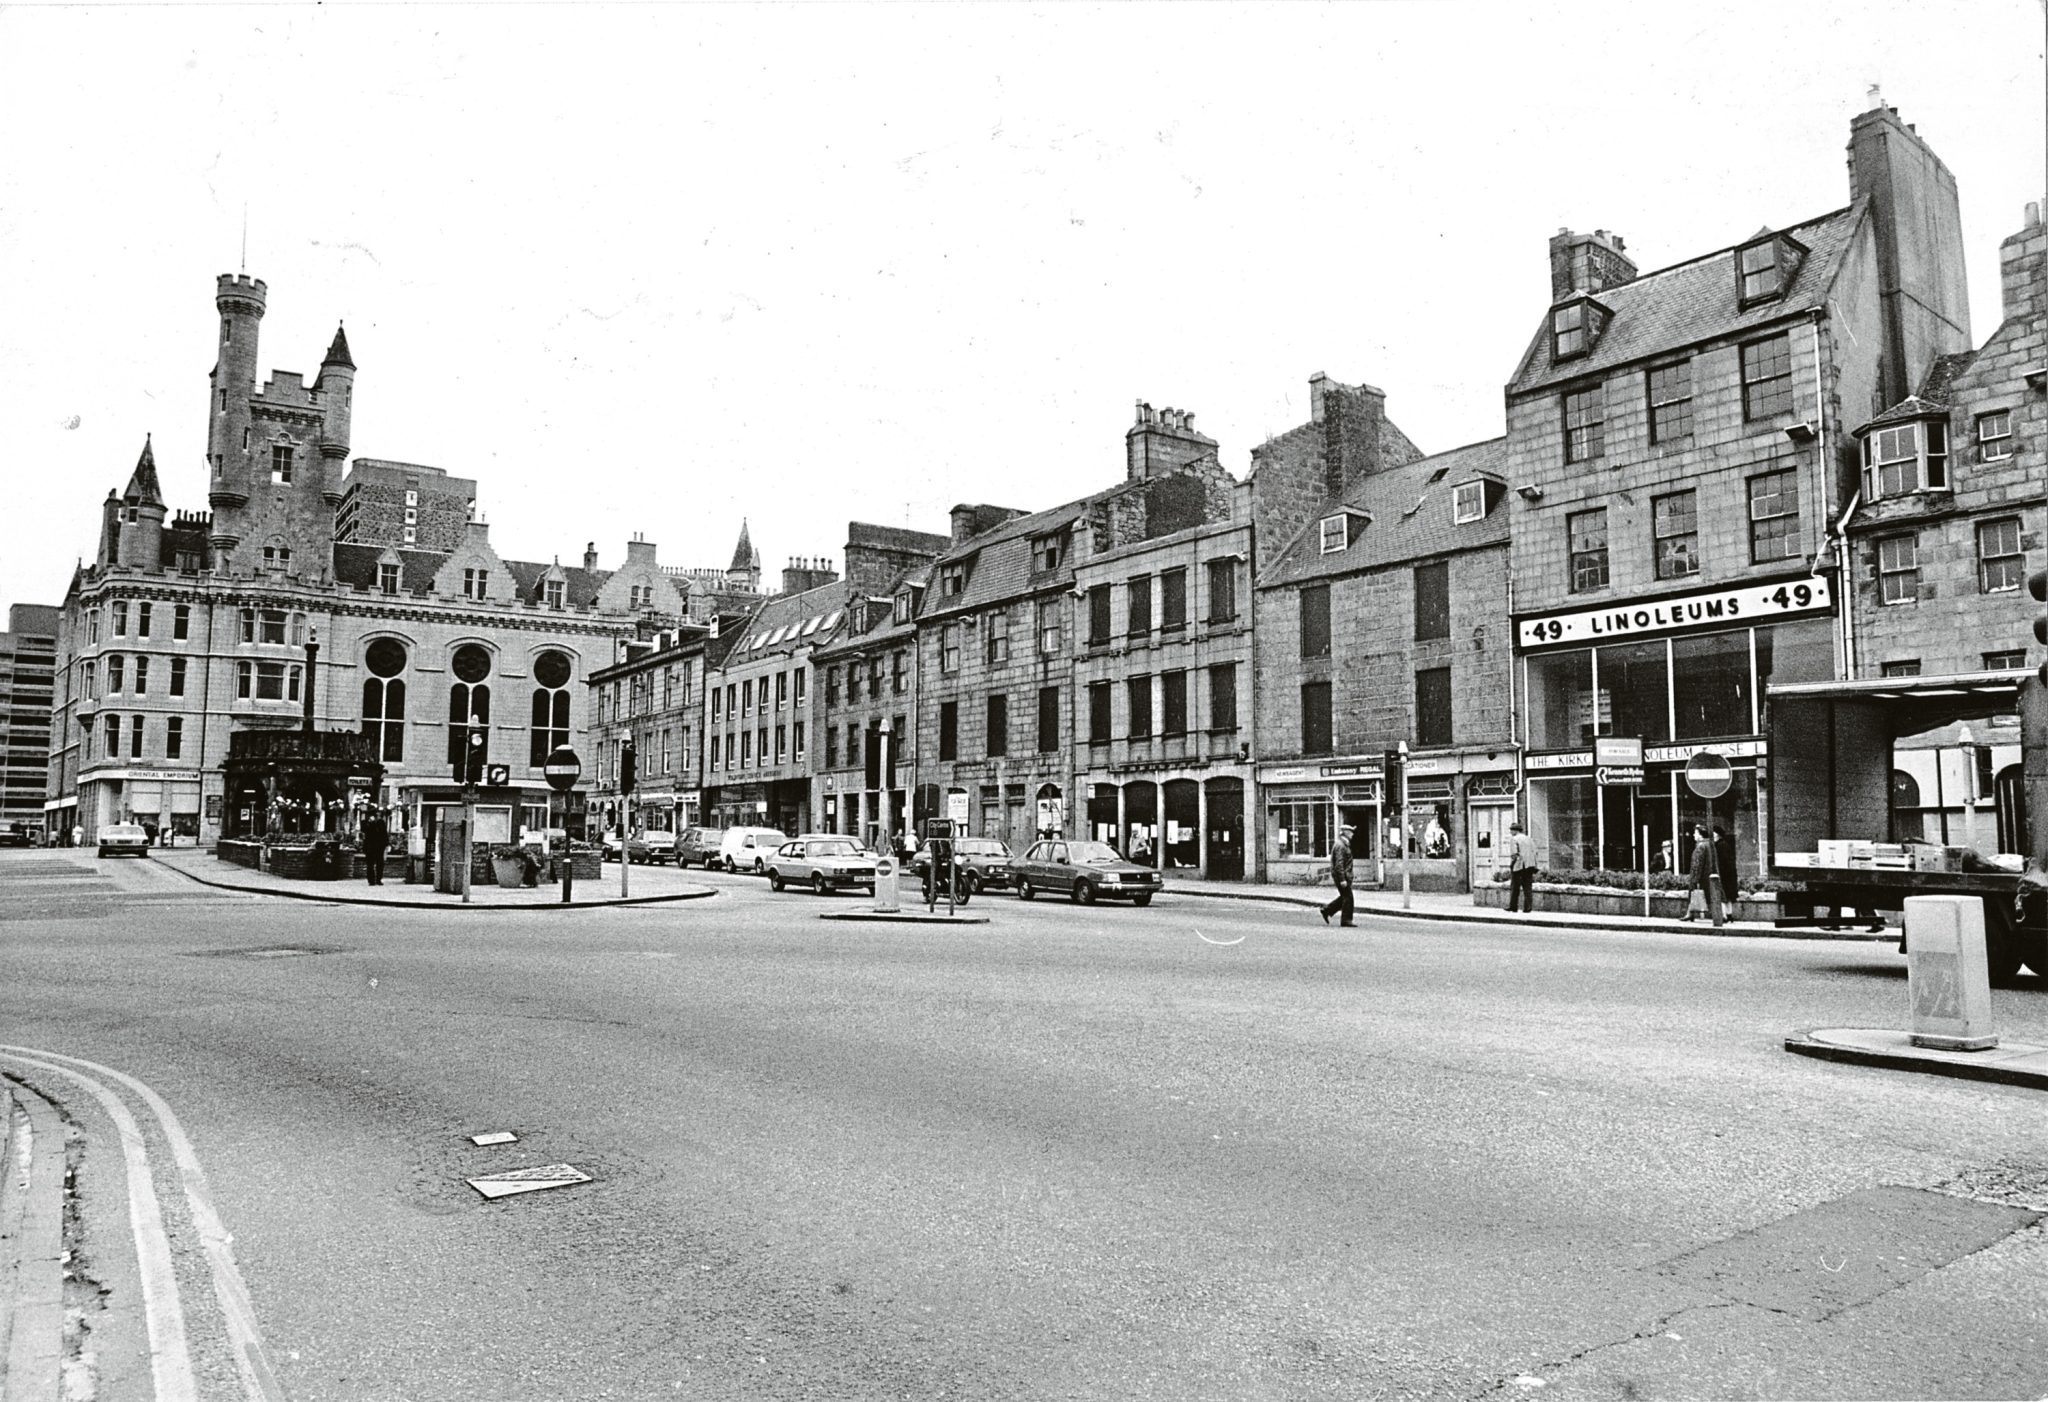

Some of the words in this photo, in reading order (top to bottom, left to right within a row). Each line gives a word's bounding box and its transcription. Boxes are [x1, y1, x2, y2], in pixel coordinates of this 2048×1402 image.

[1591, 598, 1740, 634] LINOLEUMS
[1532, 757, 1548, 767] THE
[1558, 752, 1593, 766] KIRKC
[1643, 746, 1692, 761] NOLEUM
[1330, 767, 1357, 775] Embassy
[1359, 765, 1381, 773] REGAL
[1405, 761, 1436, 769] TATIONER
